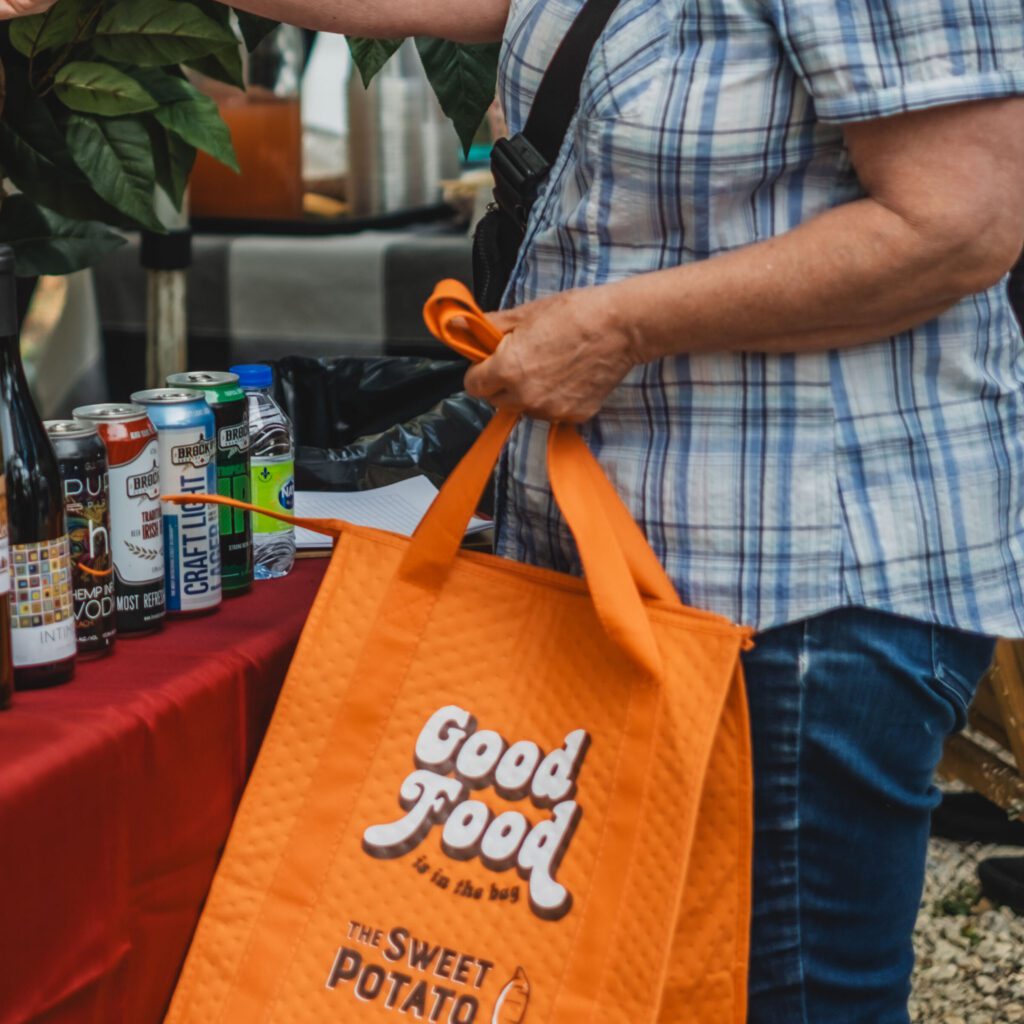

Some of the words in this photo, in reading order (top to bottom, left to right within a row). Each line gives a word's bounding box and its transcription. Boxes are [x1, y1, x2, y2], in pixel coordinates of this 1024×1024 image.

[182, 534, 209, 596] CRAFT
[74, 596, 114, 621] VOD
[116, 593, 139, 611] MOST
[414, 704, 592, 810] Good
[361, 769, 583, 922] Food
[430, 867, 451, 890] in
[453, 879, 484, 901] the
[488, 882, 521, 905] bag
[325, 945, 481, 1024] POTATO
[347, 920, 384, 949] THE
[382, 926, 495, 991] SWEET
